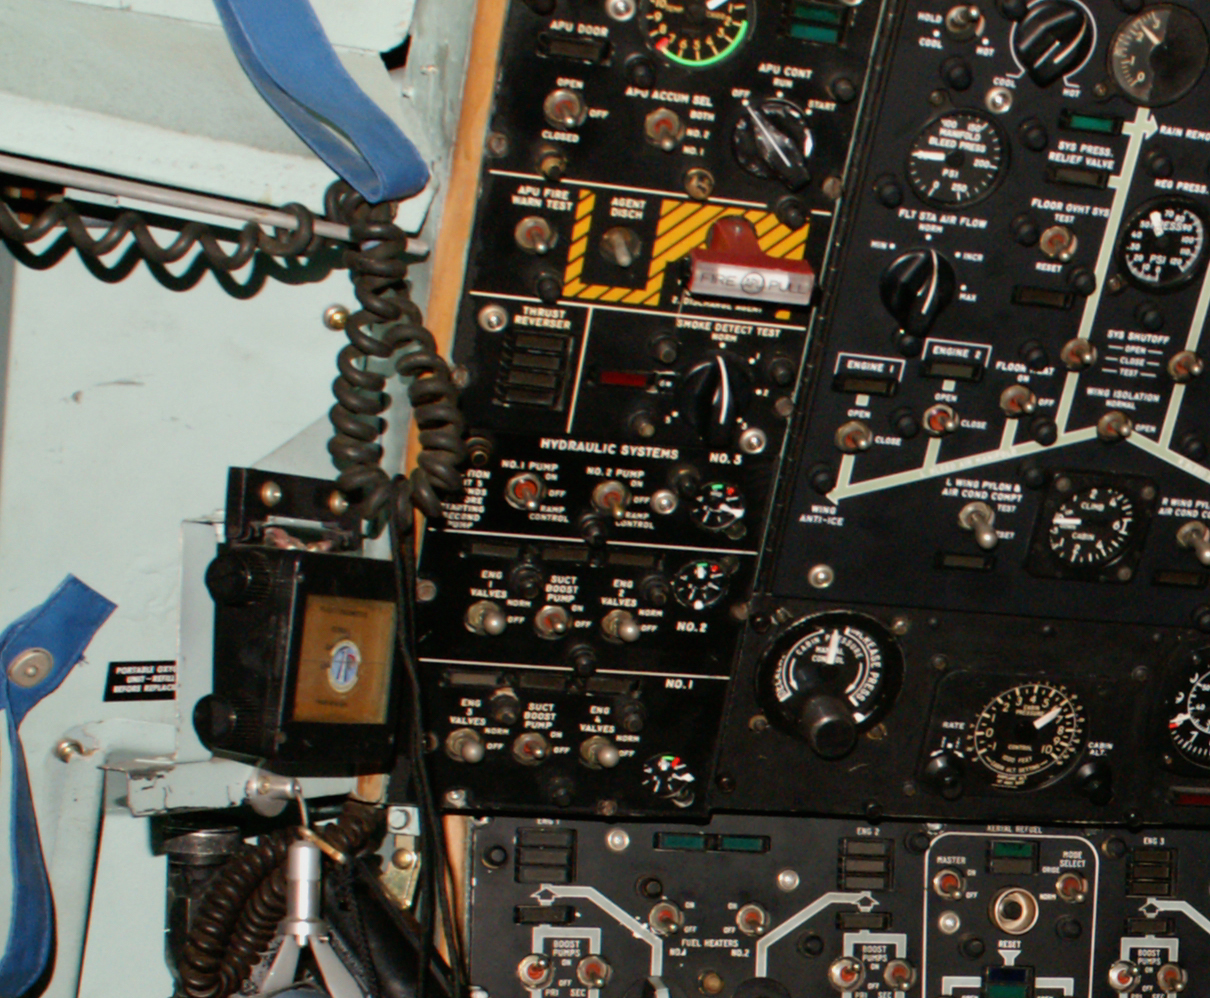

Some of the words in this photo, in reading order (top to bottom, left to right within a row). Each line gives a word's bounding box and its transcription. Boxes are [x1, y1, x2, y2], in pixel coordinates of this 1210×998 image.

[918, 12, 942, 24] HOLD
[550, 20, 574, 32] APU
[577, 24, 609, 37] DOOR
[759, 63, 781, 75] APU
[784, 66, 812, 79] CONT
[557, 78, 583, 90] OPEN
[625, 86, 648, 98] APU
[651, 89, 690, 103] ACCUM
[693, 95, 714, 107] SEL
[808, 100, 836, 111] START
[542, 130, 579, 143] CLOSED
[940, 127, 981, 141] MANIFOLD
[1159, 125, 1185, 137] RAIN
[929, 135, 957, 148] BLEED
[960, 141, 986, 153] PRESS
[1058, 141, 1077, 152] SYS
[1048, 152, 1084, 165] RELIEF
[1086, 157, 1115, 170] VALVE
[942, 168, 959, 178] PSI
[518, 185, 540, 197] APU
[542, 188, 569, 200] FIRE
[512, 195, 543, 207] WARN
[545, 198, 573, 211] TEST
[611, 197, 646, 209] AGENT
[1032, 198, 1063, 211] FLOOR
[1092, 207, 1110, 218] SYS
[611, 208, 643, 219] DISCH
[899, 208, 917, 220] FLT
[920, 211, 939, 222] STA
[941, 214, 958, 224] AIR
[960, 216, 987, 229] FLOW
[1035, 262, 1062, 272] RESET
[701, 273, 737, 286] FIRE
[769, 280, 805, 294] PULL
[523, 306, 565, 319] THRUST
[514, 314, 570, 329] REVERSER
[676, 319, 712, 331] SMOKE
[714, 322, 752, 335] DETECT
[755, 326, 780, 338] TEST
[1107, 331, 1124, 341] SYS
[1128, 333, 1169, 345] SHUTOFF
[933, 346, 970, 357] ENGINE
[847, 360, 883, 372] ENGINE
[1086, 387, 1110, 398] WING
[1113, 389, 1159, 402] ISOLATION
[540, 438, 616, 454] HYDRAULIC
[621, 444, 679, 460] SYSTEMS
[528, 462, 558, 472] PUMP
[955, 479, 979, 489] WING
[981, 481, 1011, 492] PYLON
[942, 487, 958, 497] AIR
[960, 489, 988, 499] COND
[990, 491, 1022, 502] COMPT
[811, 506, 837, 515] WING
[529, 512, 569, 524] CONTROL
[799, 515, 844, 526] ANTI-ICE
[550, 575, 577, 585] SUCT
[470, 588, 507, 599] VALVES
[546, 584, 578, 594] BOOST
[547, 593, 575, 603] PUMP
[937, 856, 966, 865] MASTER
[1059, 859, 1086, 868] SELECT
[553, 940, 580, 948] BOOST
[682, 939, 701, 947] FUEL
[704, 939, 739, 948] HEATERS
[998, 940, 1021, 949] RESET
[552, 949, 580, 957] PUMPS
[570, 989, 586, 998] SEC
